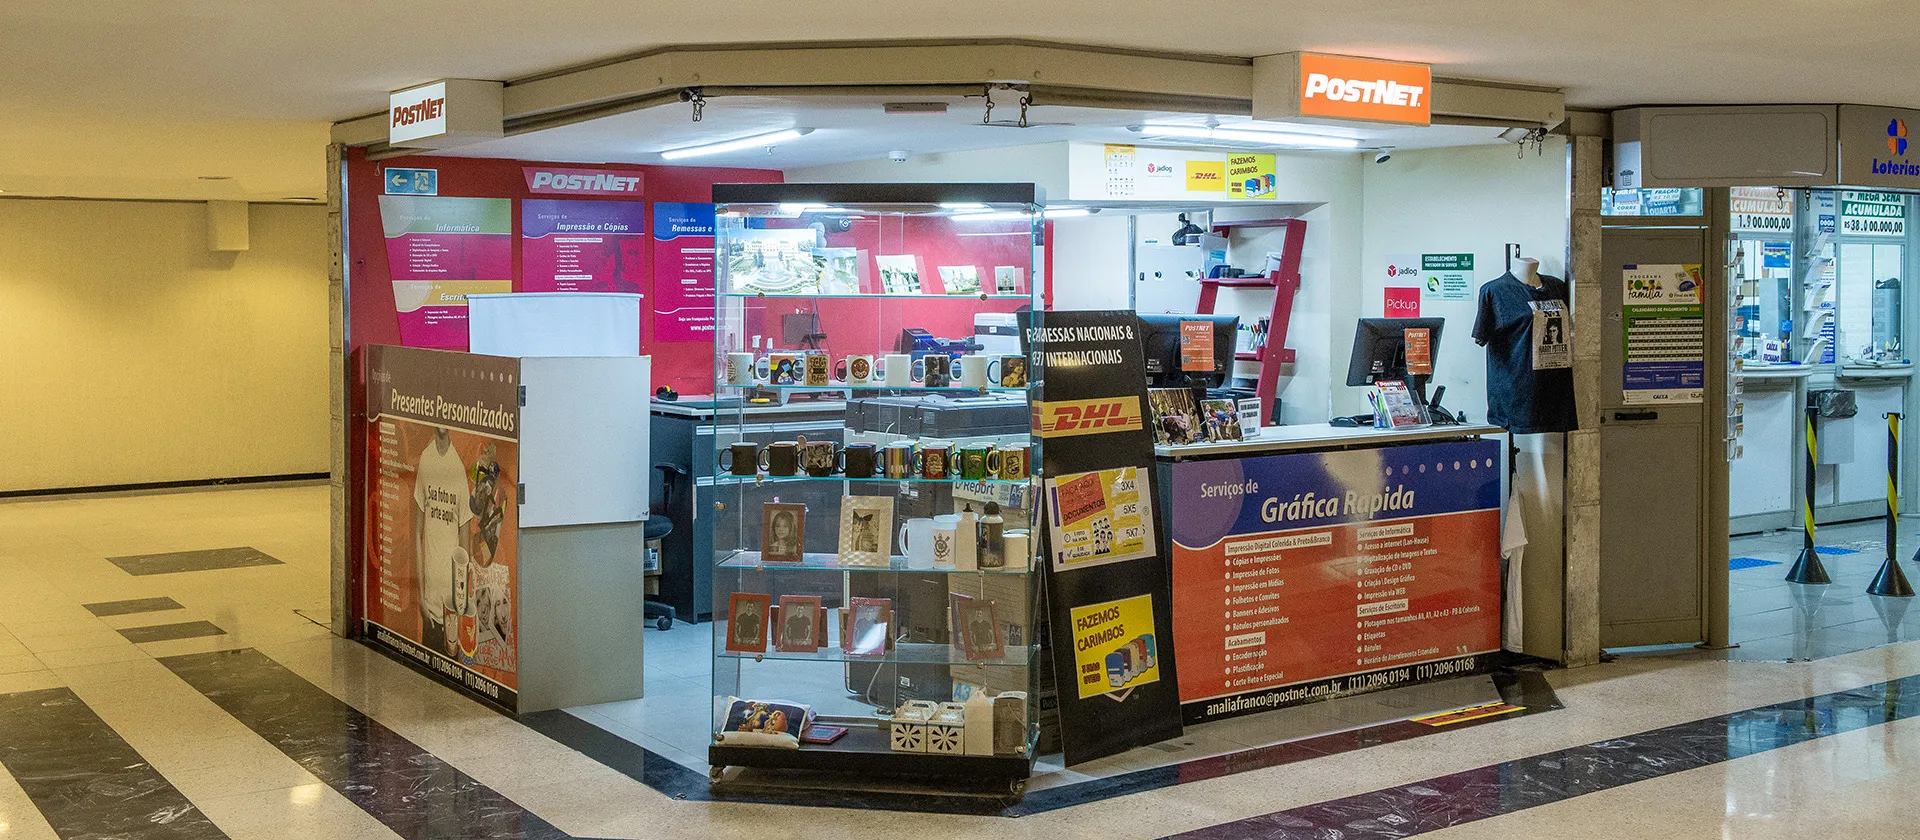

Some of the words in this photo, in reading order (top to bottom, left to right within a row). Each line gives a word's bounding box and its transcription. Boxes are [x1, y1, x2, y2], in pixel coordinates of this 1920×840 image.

[1230, 156, 1256, 164] FAZEMOS
[1156, 164, 1172, 173] jadlog
[1230, 166, 1258, 176] CARIMBOS
[1872, 158, 1920, 177] Loterias
[1195, 172, 1217, 180] DHL
[1649, 206, 1678, 215] QUARTA
[1845, 202, 1902, 217] ACUMULADA
[436, 224, 480, 232] Informática
[557, 223, 595, 231] Impressão
[604, 223, 629, 232] Cópias
[672, 224, 706, 232] Remessas
[1398, 267, 1418, 276] jadlog
[1628, 288, 1663, 299] família
[1386, 298, 1418, 311] Pickup
[1076, 325, 1125, 342] NACIONAIS
[1126, 325, 1134, 340] &
[1046, 349, 1123, 368] INTERNACIONAIS
[391, 389, 434, 418] Presentes
[436, 395, 514, 432] Personalizados
[1054, 403, 1128, 431] DHL
[963, 482, 995, 495] Report
[1012, 486, 1023, 496] A4
[1121, 480, 1134, 491] 3X4
[1201, 481, 1243, 499] Serviços
[1245, 478, 1258, 494] de
[428, 485, 437, 501] Sua
[438, 487, 449, 503] foto
[450, 493, 457, 505] ou
[1063, 498, 1106, 521] DOCUMENTOS
[1124, 504, 1136, 515] 5X5
[1261, 492, 1339, 523] Gráfica
[431, 507, 441, 519] arte
[442, 508, 453, 525] aqui
[1126, 527, 1138, 537] 5X7
[1360, 530, 1378, 539] Serviços
[1385, 527, 1411, 535] Informática
[1228, 544, 1254, 553] Impressão
[1254, 542, 1271, 551] Digital
[1272, 539, 1292, 548] Colorida
[1232, 557, 1249, 566] Cópias
[1254, 554, 1282, 565] Impressões
[1364, 554, 1393, 564] Digitalização
[1400, 550, 1420, 560] Imagens
[1423, 548, 1438, 556] Textos
[1232, 570, 1258, 579] Impressão
[1266, 566, 1280, 574] Fotos
[1364, 566, 1385, 575] Gravação
[1402, 562, 1412, 570] DVD
[1232, 583, 1258, 592] Impressão
[1267, 579, 1284, 588] Mídias
[1364, 579, 1381, 588] Criação
[1384, 577, 1399, 585] Design
[1400, 574, 1415, 582] Gráfico
[1233, 595, 1254, 605] Folhetos
[1259, 592, 1280, 601] Convites
[1364, 590, 1387, 600] Impressão
[1395, 587, 1406, 595] WEB
[1233, 609, 1254, 618] Banners
[1258, 605, 1280, 614] Adesivos
[1359, 607, 1378, 615] Serviços
[1385, 602, 1406, 610] Escritório
[1076, 605, 1121, 633] FAZEMOS
[1252, 616, 1290, 629] personalizados
[1364, 620, 1386, 628] Plotagem
[1395, 614, 1417, 623] tamanhos
[1010, 626, 1022, 638] A4
[1077, 624, 1125, 652] CARIMBOS
[1364, 632, 1386, 640] Etiquetas
[1228, 636, 1262, 647] Acabamentos
[1233, 648, 1267, 660] Encadernação
[1382, 654, 1387, 662] de
[1233, 661, 1265, 674] Plastificação
[465, 671, 475, 689] (11)
[475, 676, 486, 693] 2096
[1233, 679, 1247, 687] Corte
[1247, 676, 1259, 684] Reto
[1263, 671, 1284, 682] Especial
[953, 683, 972, 700] A3
[1207, 680, 1342, 716] analiafranco@postnet.com.br
[1348, 675, 1366, 690] (11)
[1367, 671, 1388, 688] 2096
[1389, 669, 1410, 684] 0194
[1416, 665, 1433, 681] (11)
[1434, 661, 1454, 677] 2096
[1455, 657, 1475, 672] 0168
